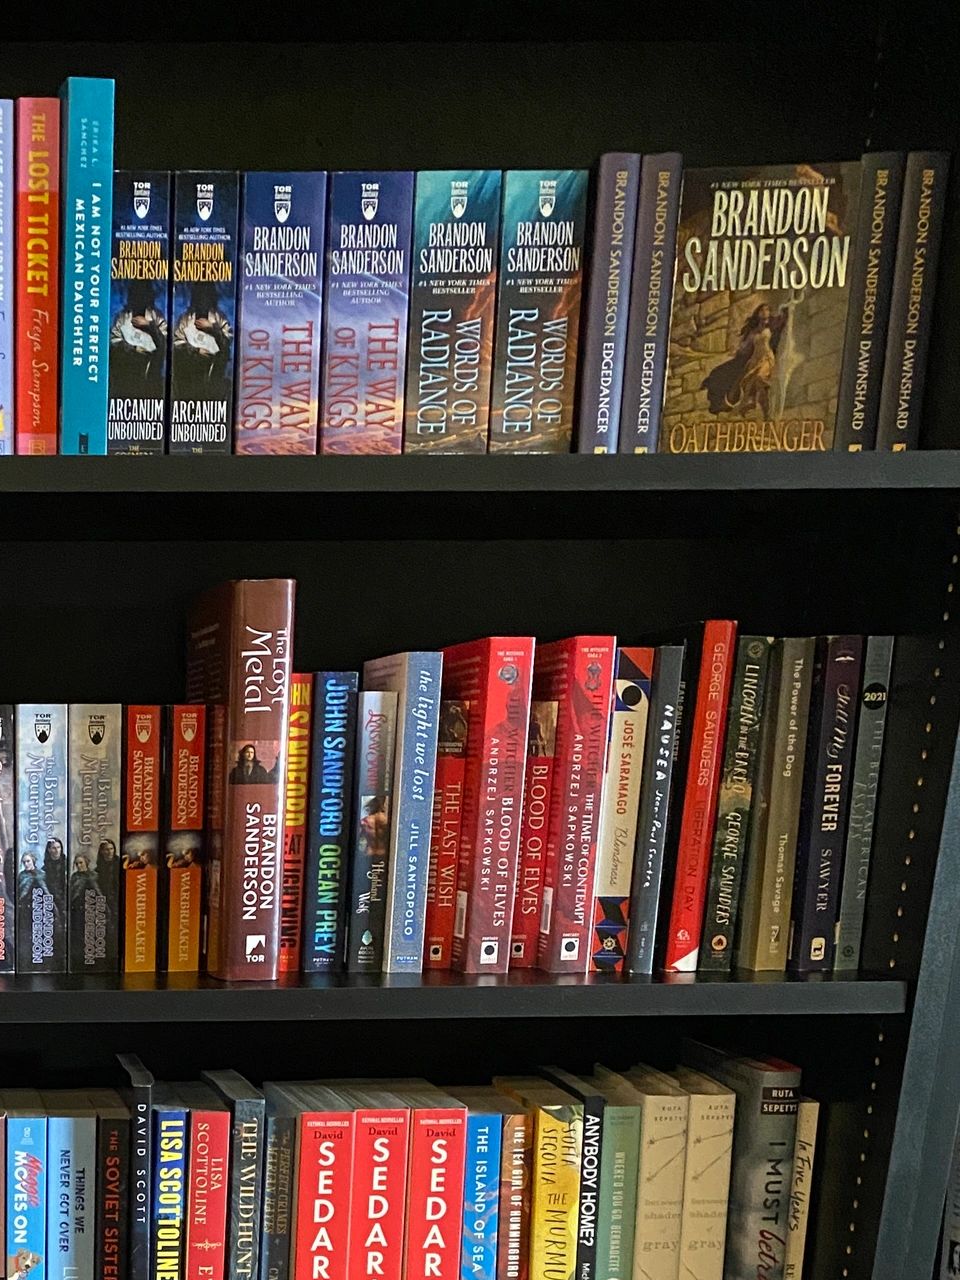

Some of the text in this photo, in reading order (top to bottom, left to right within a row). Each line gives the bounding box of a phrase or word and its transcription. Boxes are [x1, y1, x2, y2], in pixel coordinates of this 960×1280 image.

[27, 113, 49, 297] THE LOST TICKET
[92, 196, 100, 219] AM
[711, 187, 831, 236] BRANDON
[92, 226, 100, 255] NOT
[245, 252, 317, 277] SANDERSON
[254, 227, 310, 250] BRANDON
[683, 236, 850, 292] SANDERSON
[74, 199, 84, 366] MEXICAN DAUGHTER
[91, 263, 100, 307] YOUR
[597, 171, 628, 434] BRANDON SANDERSON EDGEDANCER
[89, 315, 99, 383] PERFECT
[242, 329, 273, 430] OF KINGS
[280, 321, 314, 435] THE WAY
[416, 308, 453, 434] RADIANCE
[452, 317, 482, 424] WORDS OF
[108, 421, 163, 442] UNBOUNDED
[109, 399, 163, 421] ARCANUM
[670, 421, 825, 453] OATHBRINGER
[243, 625, 272, 714] Metal
[267, 628, 288, 702] The Lost
[864, 693, 886, 701] 2021
[413, 670, 432, 801] the light we lost
[617, 719, 634, 816] JOSÉ SARAMAGO
[656, 705, 673, 780] NAUSEA
[315, 679, 347, 955] JOHN SANFORD OCEAN PREY
[481, 738, 500, 891] ANDRZEJ SAPKOWSKI
[821, 765, 842, 831] FOREVER
[404, 823, 420, 936] JILL SANTOPOLO
[160, 1120, 183, 1163] LISA
[313, 1131, 342, 1139] David
[477, 1127, 488, 1154] THE
[196, 1122, 209, 1224] SCOTTOLINE
[210, 1157, 223, 1190] LISA
[474, 1160, 487, 1212] ISLAND
[579, 1115, 601, 1247] ANYBODY HOME?
[761, 1159, 784, 1224] MUST
[472, 1246, 483, 1273] SEA
[474, 1220, 484, 1240] OF
